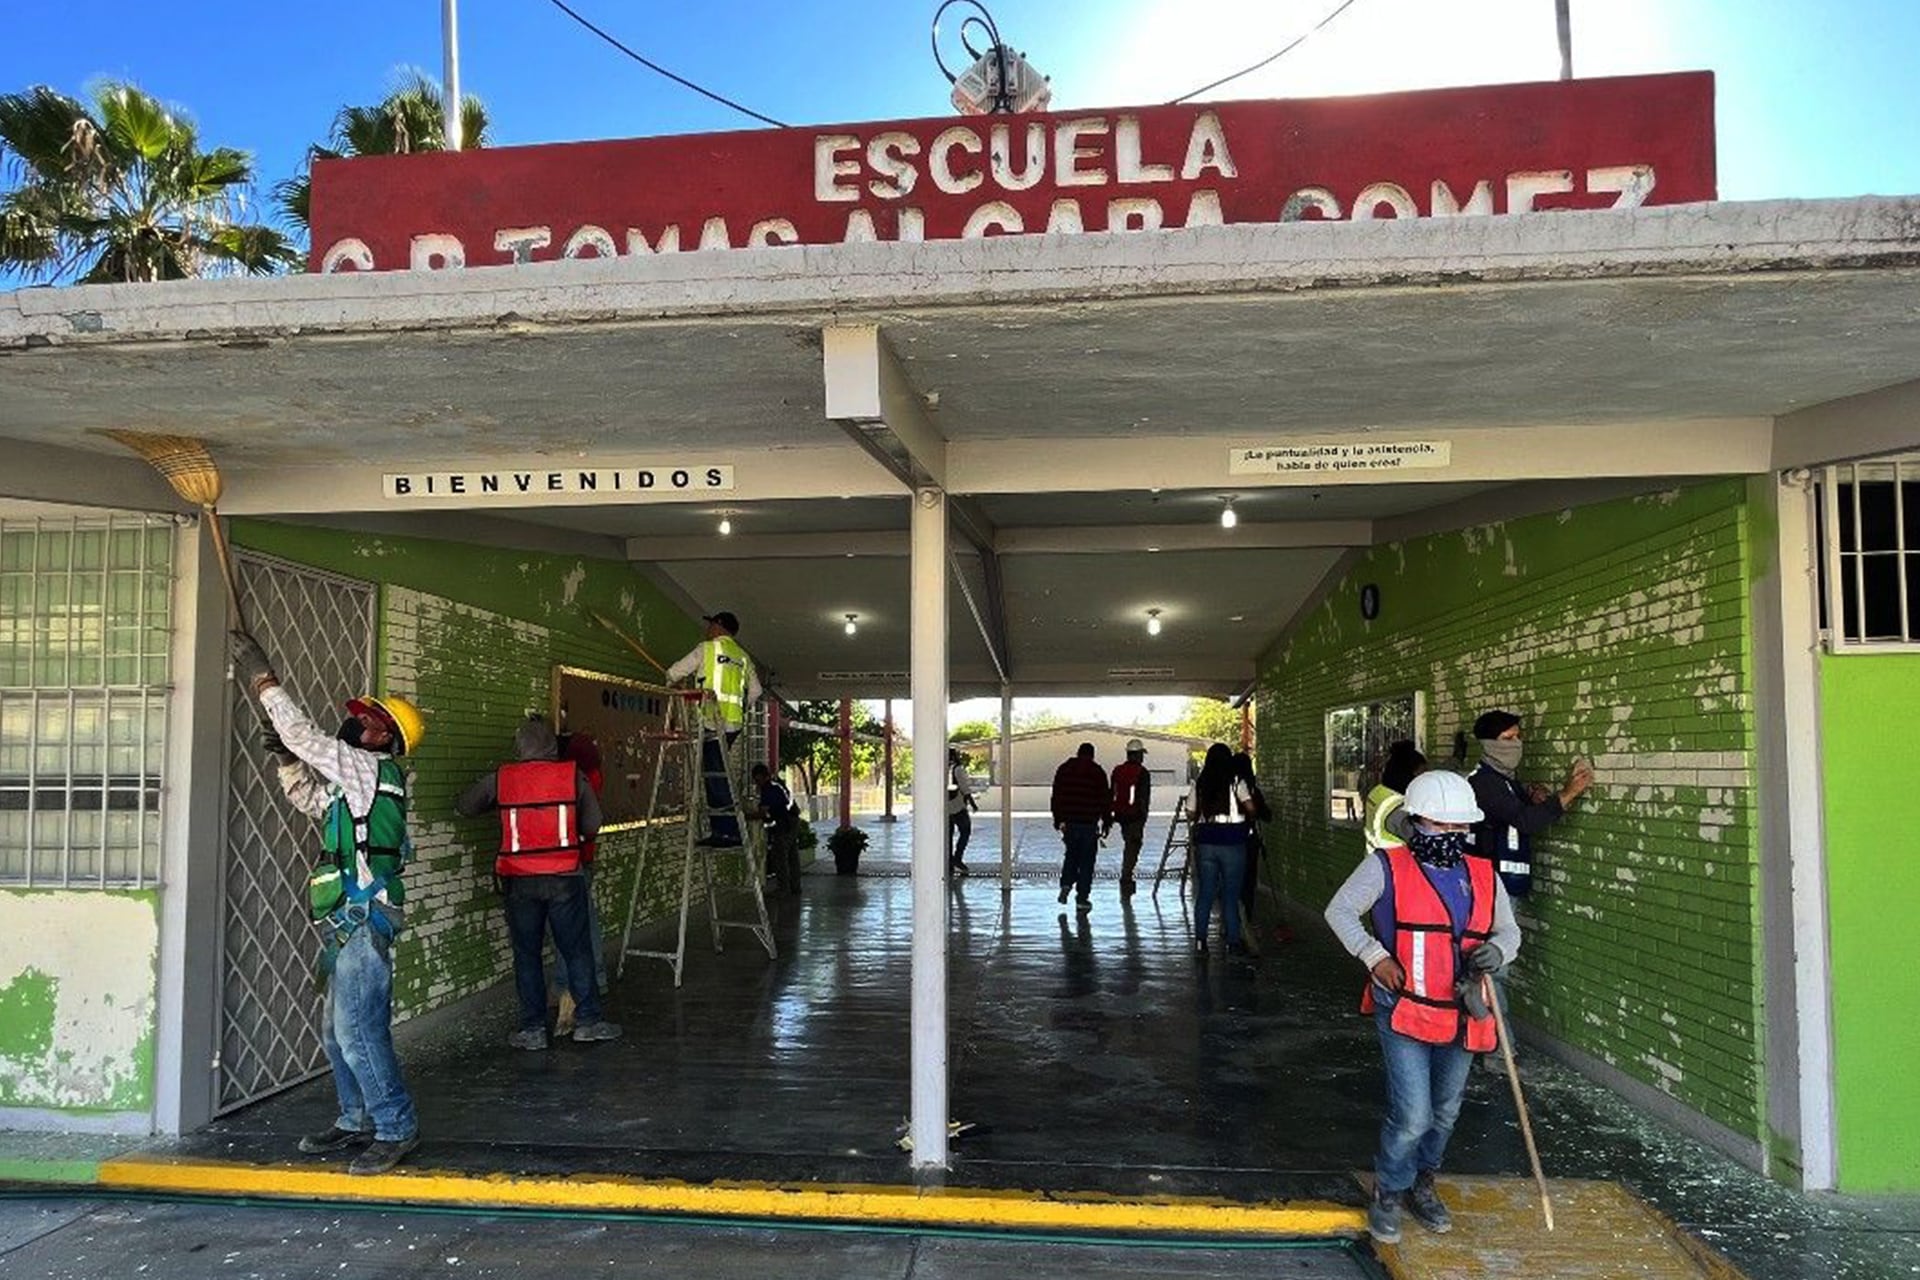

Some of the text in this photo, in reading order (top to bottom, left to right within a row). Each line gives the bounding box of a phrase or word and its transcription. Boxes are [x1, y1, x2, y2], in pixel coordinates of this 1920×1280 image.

[815, 110, 1238, 201] ESCUELA
[1342, 448, 1349, 457] y
[1353, 446, 1364, 455] la
[1276, 461, 1311, 471] habla
[1314, 460, 1329, 470] de
[395, 468, 722, 495] BIENVENIDOS
